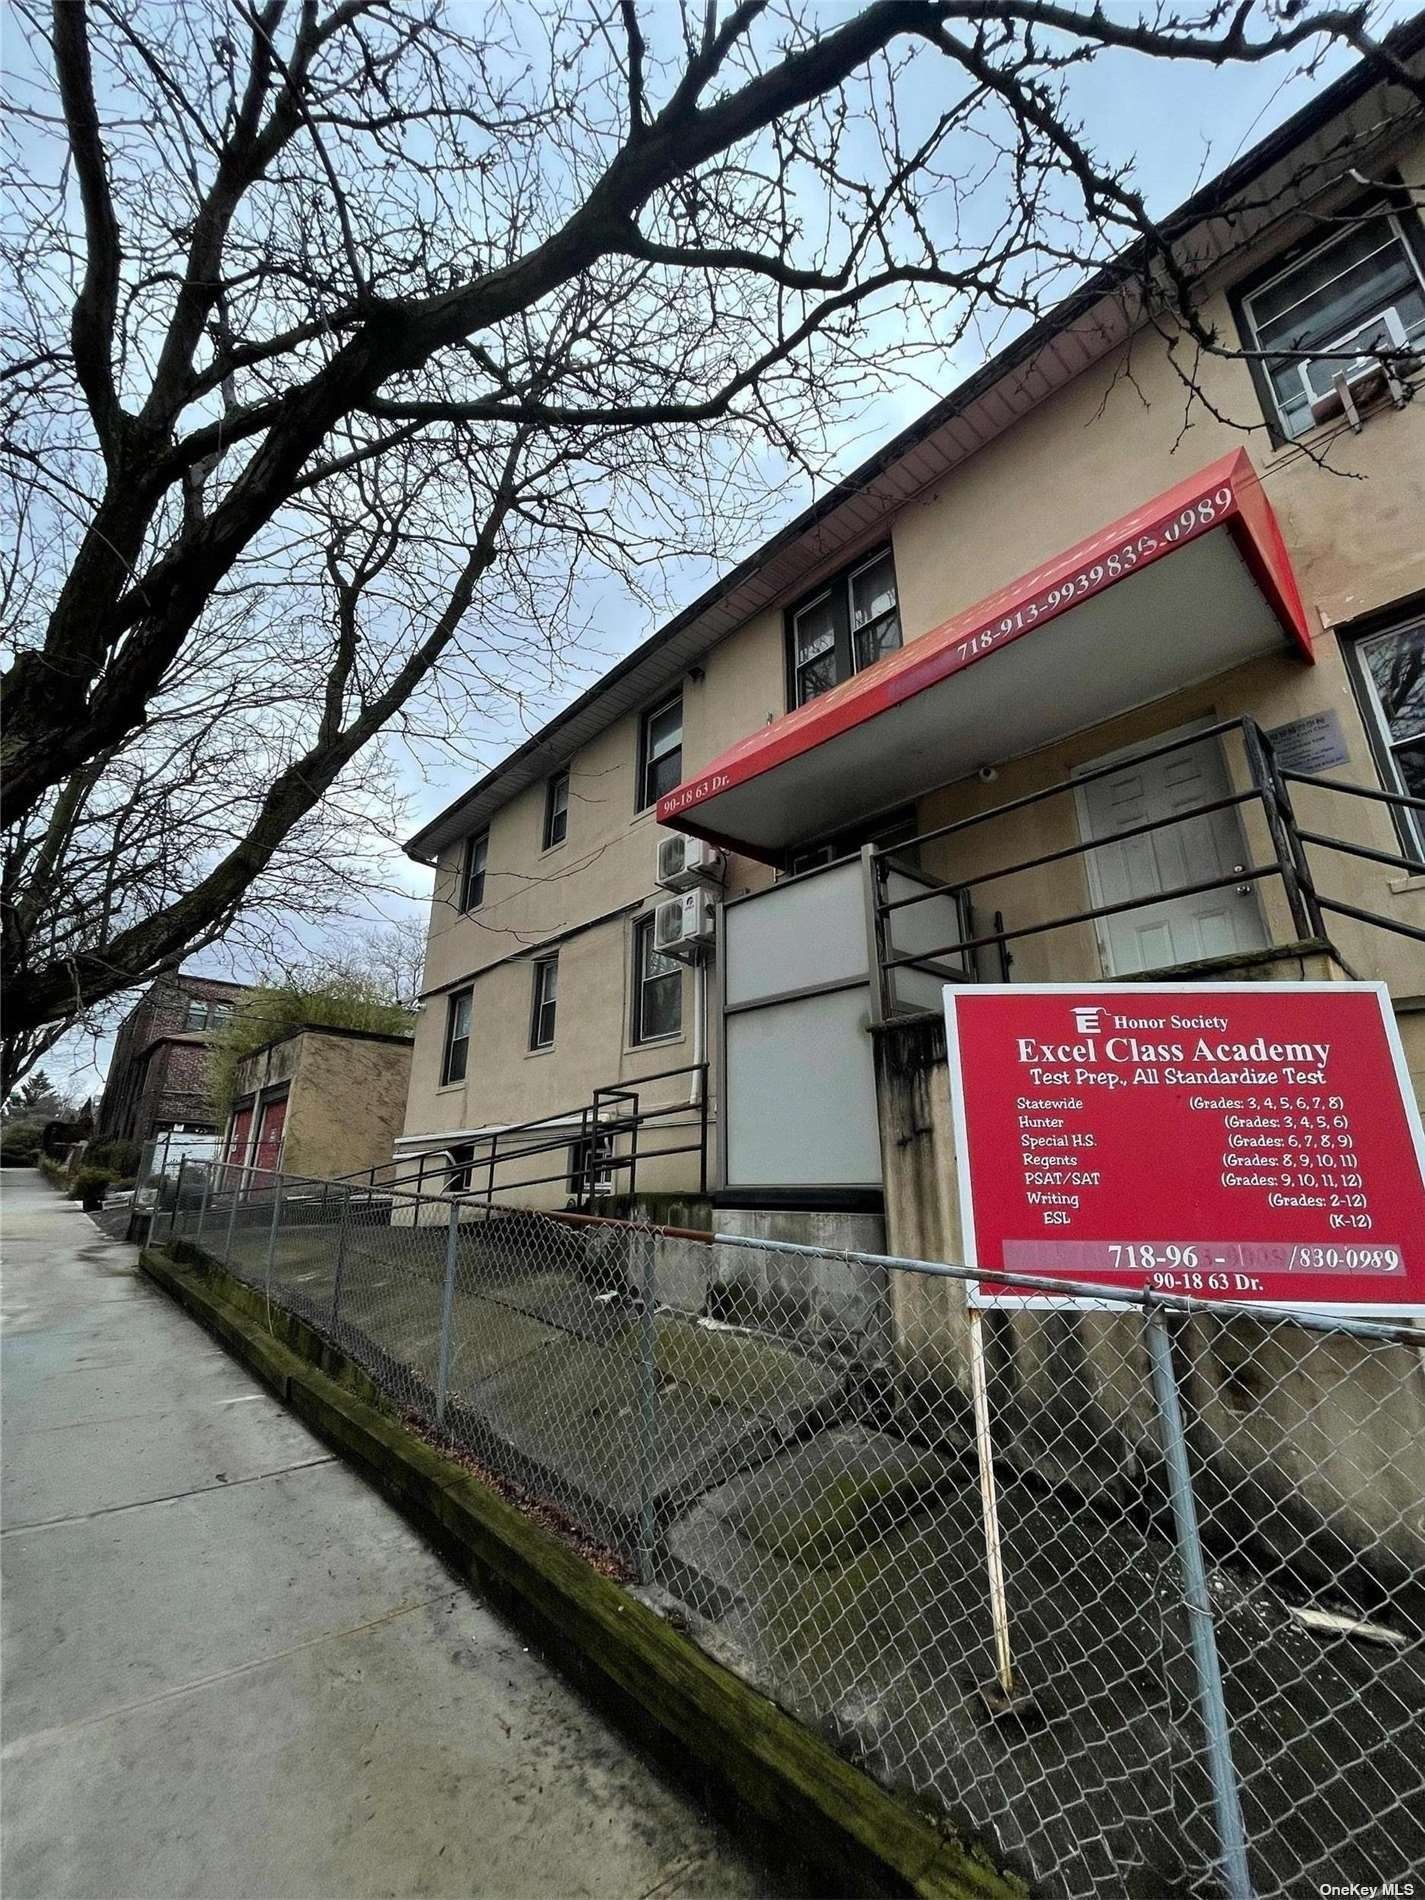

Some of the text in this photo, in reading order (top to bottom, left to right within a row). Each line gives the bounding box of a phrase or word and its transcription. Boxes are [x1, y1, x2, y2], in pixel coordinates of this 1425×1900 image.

[664, 776, 729, 813] 90-18 63 Dr.
[1113, 1014, 1228, 1033] Honor Society
[1015, 1037, 1330, 1068] Excel Class Academy
[1029, 1067, 1072, 1085] Test
[1132, 1068, 1160, 1085] All
[1164, 1067, 1279, 1085] Standardize
[1282, 1066, 1327, 1085] Test
[1017, 1097, 1083, 1110] Statewide
[1189, 1096, 1344, 1111] (Grades: 3, 4, 5, 6, 7, 8)
[1018, 1115, 1064, 1128] Hunter
[1224, 1114, 1349, 1130] (Grades: 3, 4, 5, 6)
[1020, 1133, 1097, 1150] Special H.S.
[1228, 1133, 1353, 1149] (Grades: 6, 7, 8, 9)
[1022, 1152, 1078, 1170] Regents
[1222, 1153, 1358, 1169] (Grades: 8, 9, 10, 11)
[1024, 1171, 1101, 1185] PSAT/SAT
[1221, 1172, 1363, 1189] (Grades: 9, 10, 11, 12)
[1026, 1191, 1079, 1209] Writing
[1268, 1192, 1367, 1209] (Grades: 2-12)
[1043, 1211, 1071, 1225] ESL
[1329, 1213, 1372, 1229] (K-12)
[1153, 1272, 1264, 1291] 90-18 63 Dr.
